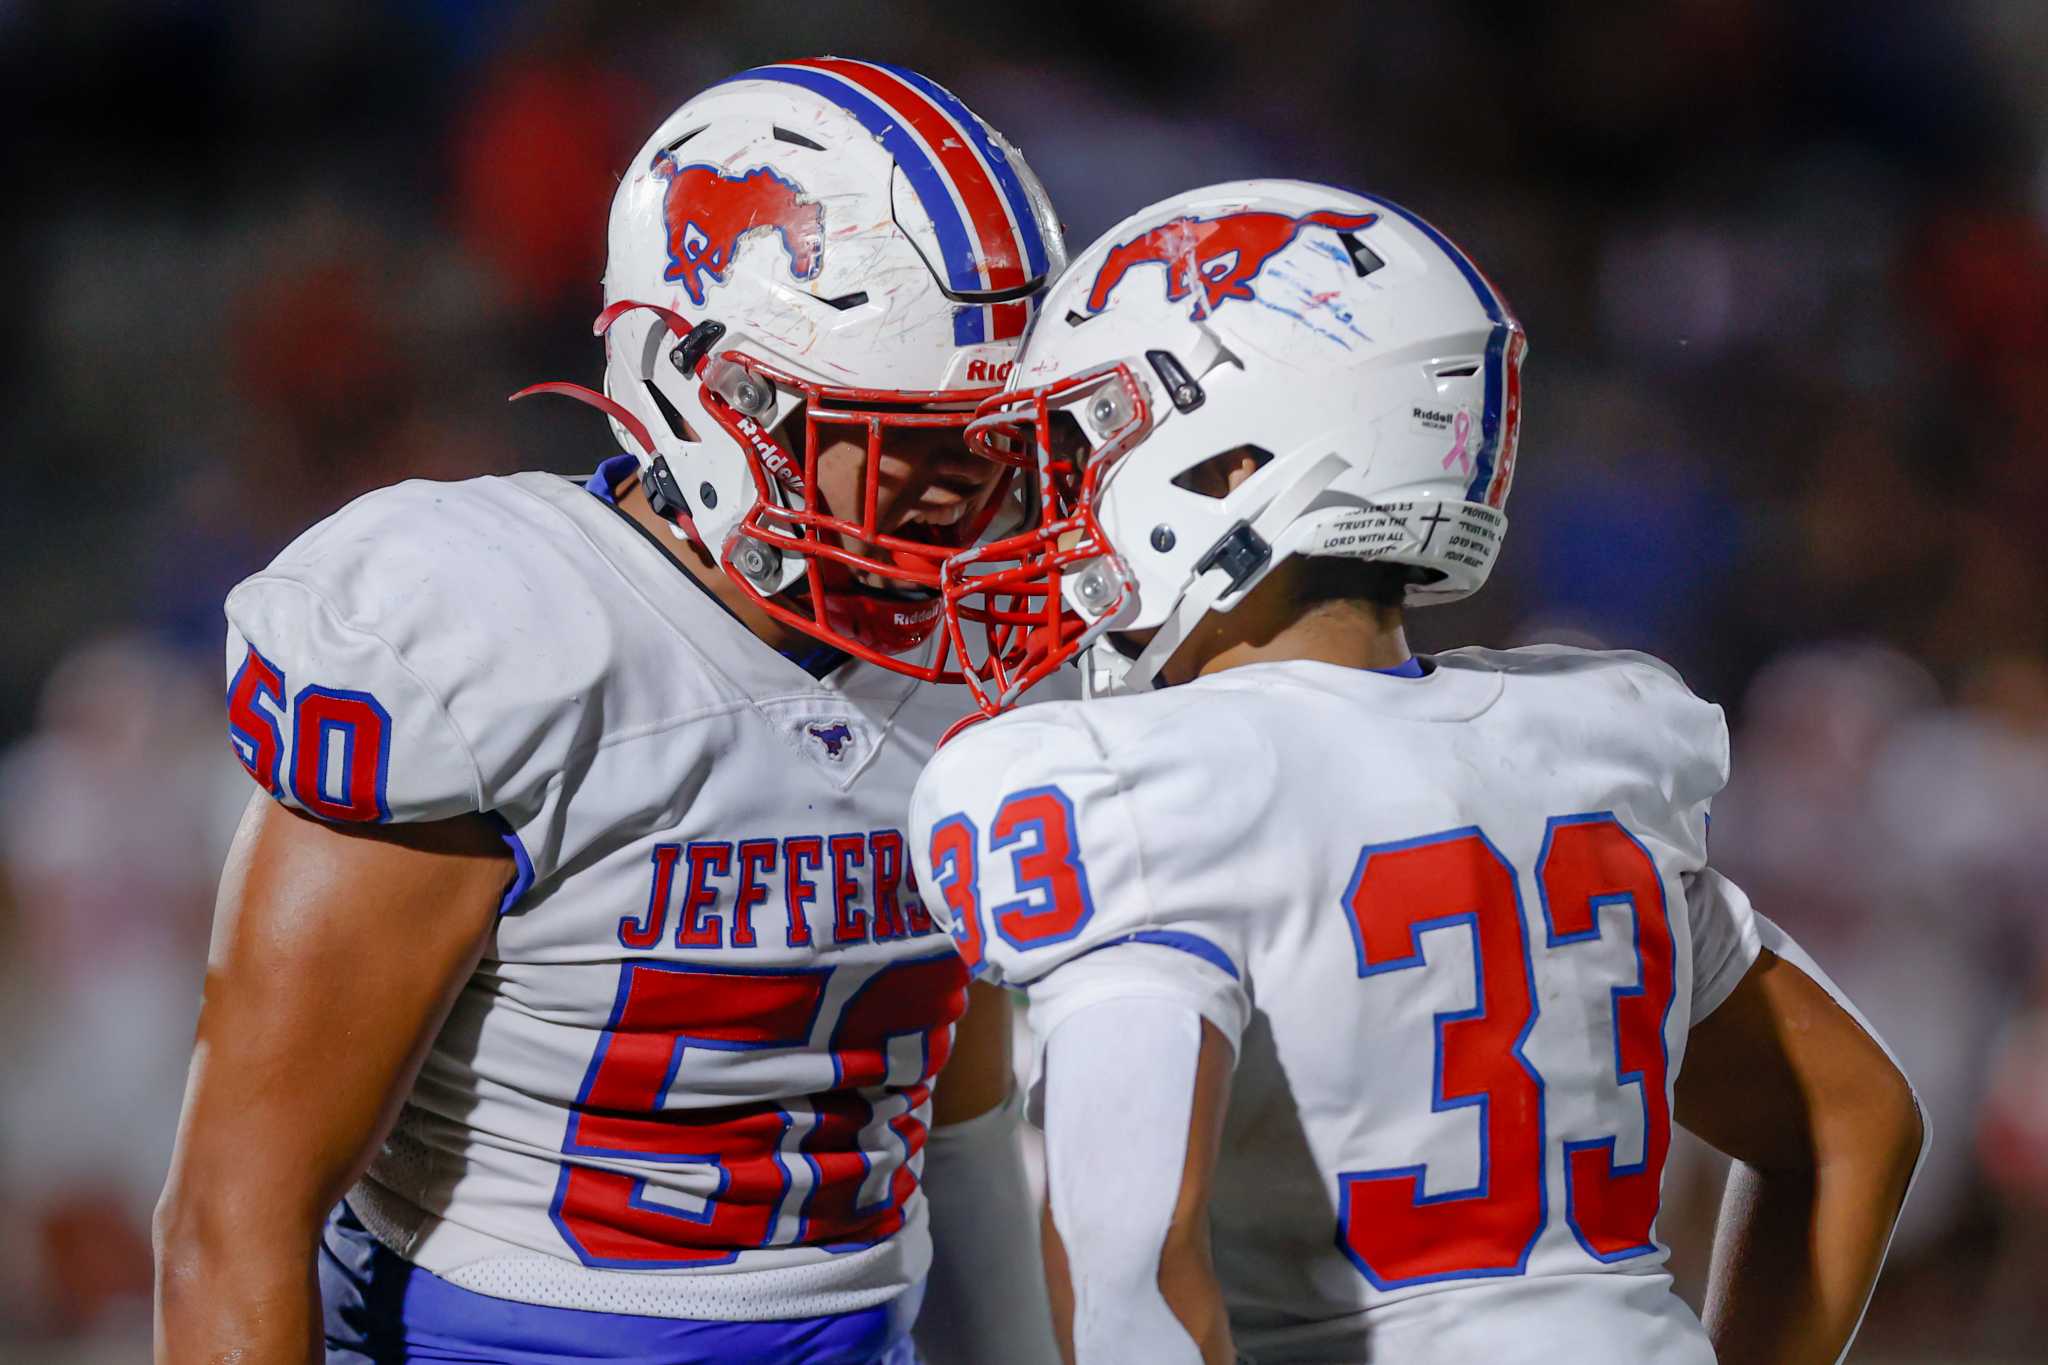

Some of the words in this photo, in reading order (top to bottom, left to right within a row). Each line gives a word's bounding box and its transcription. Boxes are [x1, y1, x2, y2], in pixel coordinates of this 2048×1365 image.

[736, 417, 806, 487] Riddell
[1413, 407, 1453, 424] Riddell
[1323, 535, 1356, 549] LORD
[1358, 532, 1385, 543] WITH
[1386, 532, 1404, 541] ALL
[1375, 519, 1387, 527] IN
[1389, 516, 1408, 527] THE
[226, 642, 393, 824] 50
[929, 783, 1095, 979] 33
[548, 950, 970, 1270] 50
[1335, 810, 1677, 1292] 33
